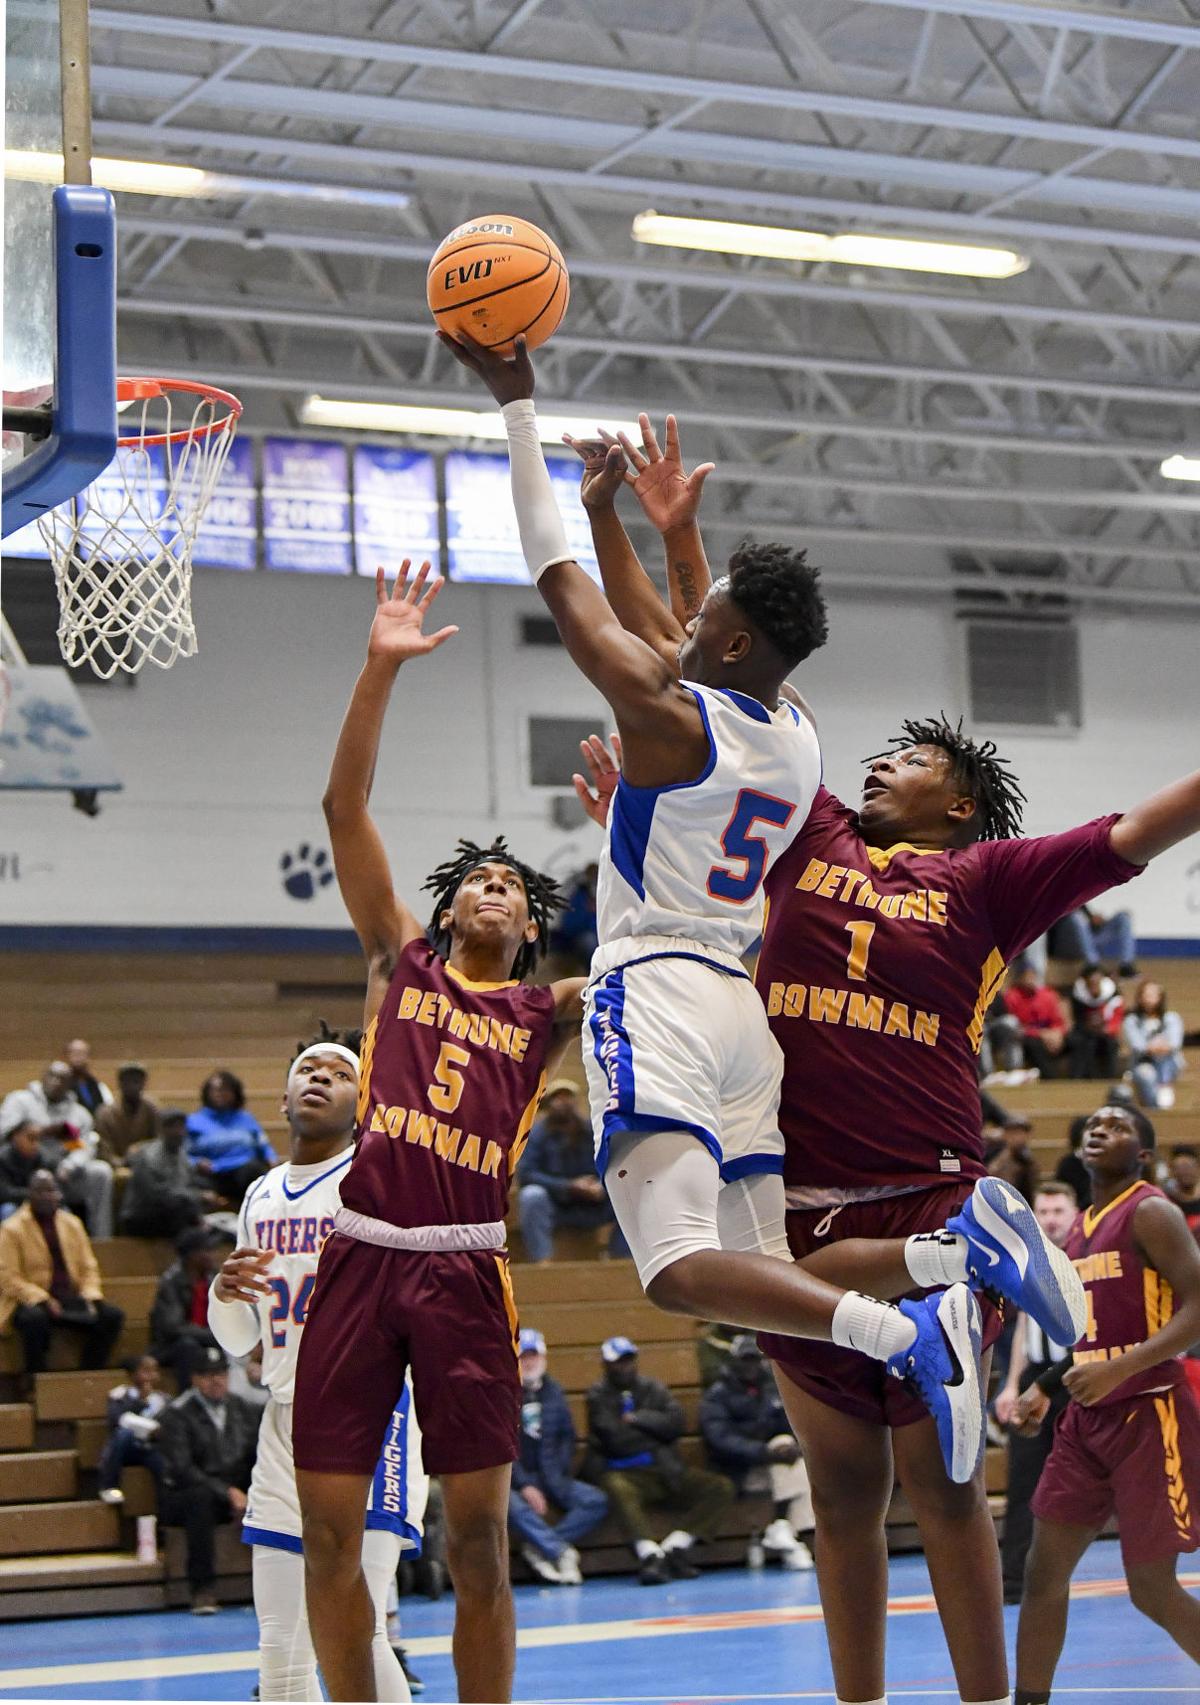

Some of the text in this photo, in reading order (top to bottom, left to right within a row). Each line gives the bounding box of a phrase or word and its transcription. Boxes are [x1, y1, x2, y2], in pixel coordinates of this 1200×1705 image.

[444, 255, 512, 291] EVO NXT
[706, 788, 798, 905] 5
[795, 857, 949, 927] BETHUNE
[845, 920, 876, 982] 1
[397, 986, 532, 1064] BETHUNE
[767, 982, 941, 1047] BOWMAN
[427, 1041, 472, 1114] 5
[369, 1103, 502, 1179] BOWMAN
[942, 1149, 955, 1158] XL
[255, 1216, 336, 1256] TIGERS
[382, 1410, 405, 1513] TIGERS
